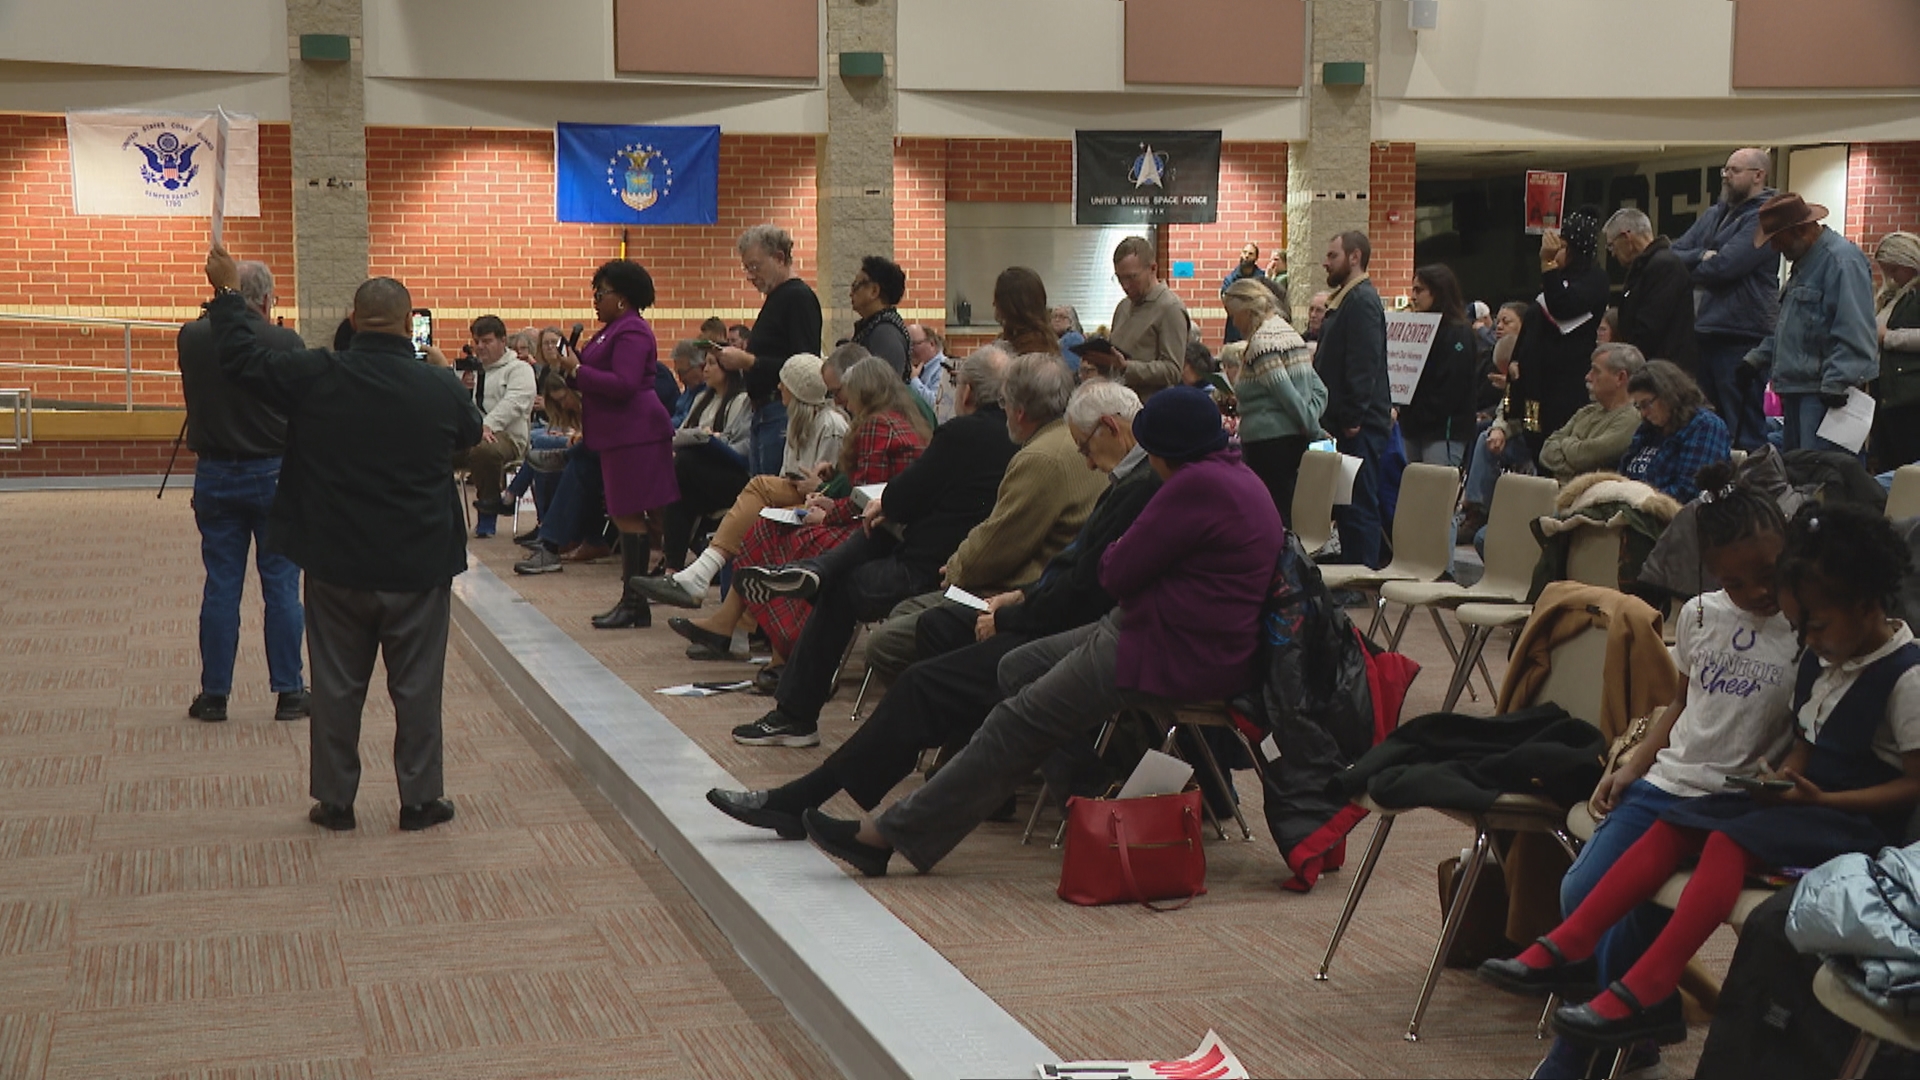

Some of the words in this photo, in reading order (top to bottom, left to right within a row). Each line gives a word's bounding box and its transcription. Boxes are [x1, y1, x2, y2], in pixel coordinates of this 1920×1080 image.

[122, 131, 139, 151] UNITED
[142, 121, 166, 133] STATES
[170, 122, 193, 133] COAST
[196, 132, 215, 151] GUARD
[145, 189, 171, 200] SEMPER
[171, 189, 200, 200] PARATUS
[1090, 195, 1118, 205] UNITED
[1121, 195, 1151, 205] STATES
[1153, 195, 1179, 205] SPACE
[1182, 195, 1209, 205] FORCE
[1387, 321, 1406, 341] DATA
[1692, 650, 1784, 686] JUNIOR
[1700, 664, 1761, 698] Cheer
